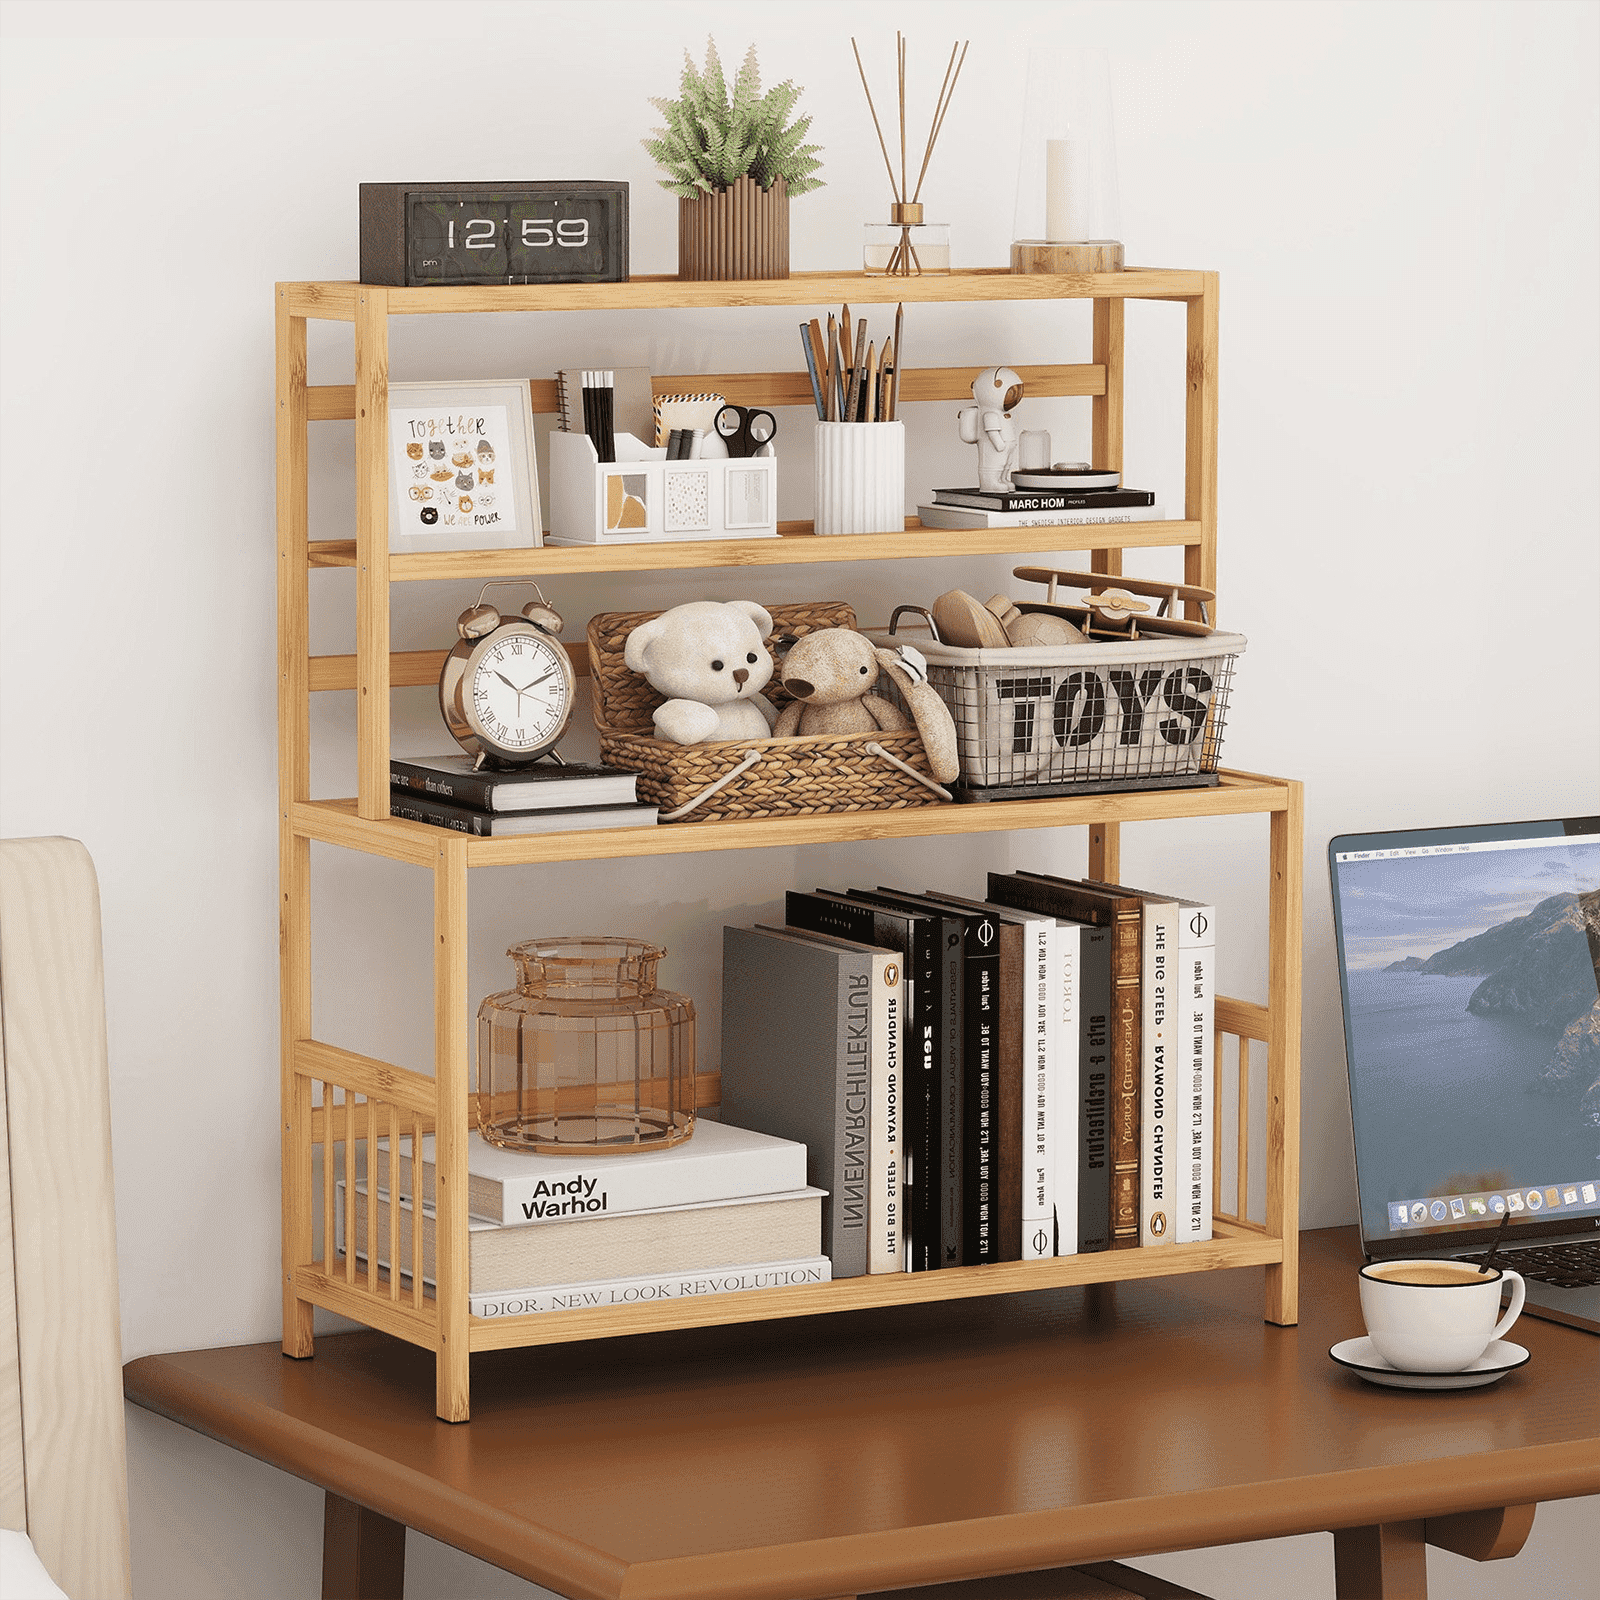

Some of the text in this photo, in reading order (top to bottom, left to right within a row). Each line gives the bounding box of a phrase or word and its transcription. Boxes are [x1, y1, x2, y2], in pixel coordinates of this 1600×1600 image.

[422, 260, 438, 268] pm
[1009, 498, 1039, 509] MARC
[1041, 498, 1065, 508] HOM
[1031, 519, 1054, 527] SWEDISH
[1057, 518, 1083, 526] INTERIOR
[512, 645, 522, 655] XII
[532, 650, 538, 659] I
[494, 651, 504, 663] XI
[483, 668, 492, 678] X
[543, 665, 552, 674] II
[479, 690, 488, 700] IX
[549, 686, 557, 694] III
[484, 706, 496, 724] VIII
[545, 704, 554, 716] IV
[995, 667, 1213, 753] TOYS
[497, 723, 508, 736] VII
[533, 721, 540, 732] V
[516, 729, 524, 739] VI
[425, 776, 436, 792] than
[437, 780, 453, 796] others
[532, 1175, 598, 1198] Andy
[522, 1192, 607, 1220] Warhol
[483, 1267, 823, 1317] DIOR. NEW LOOK REVOLUTION
